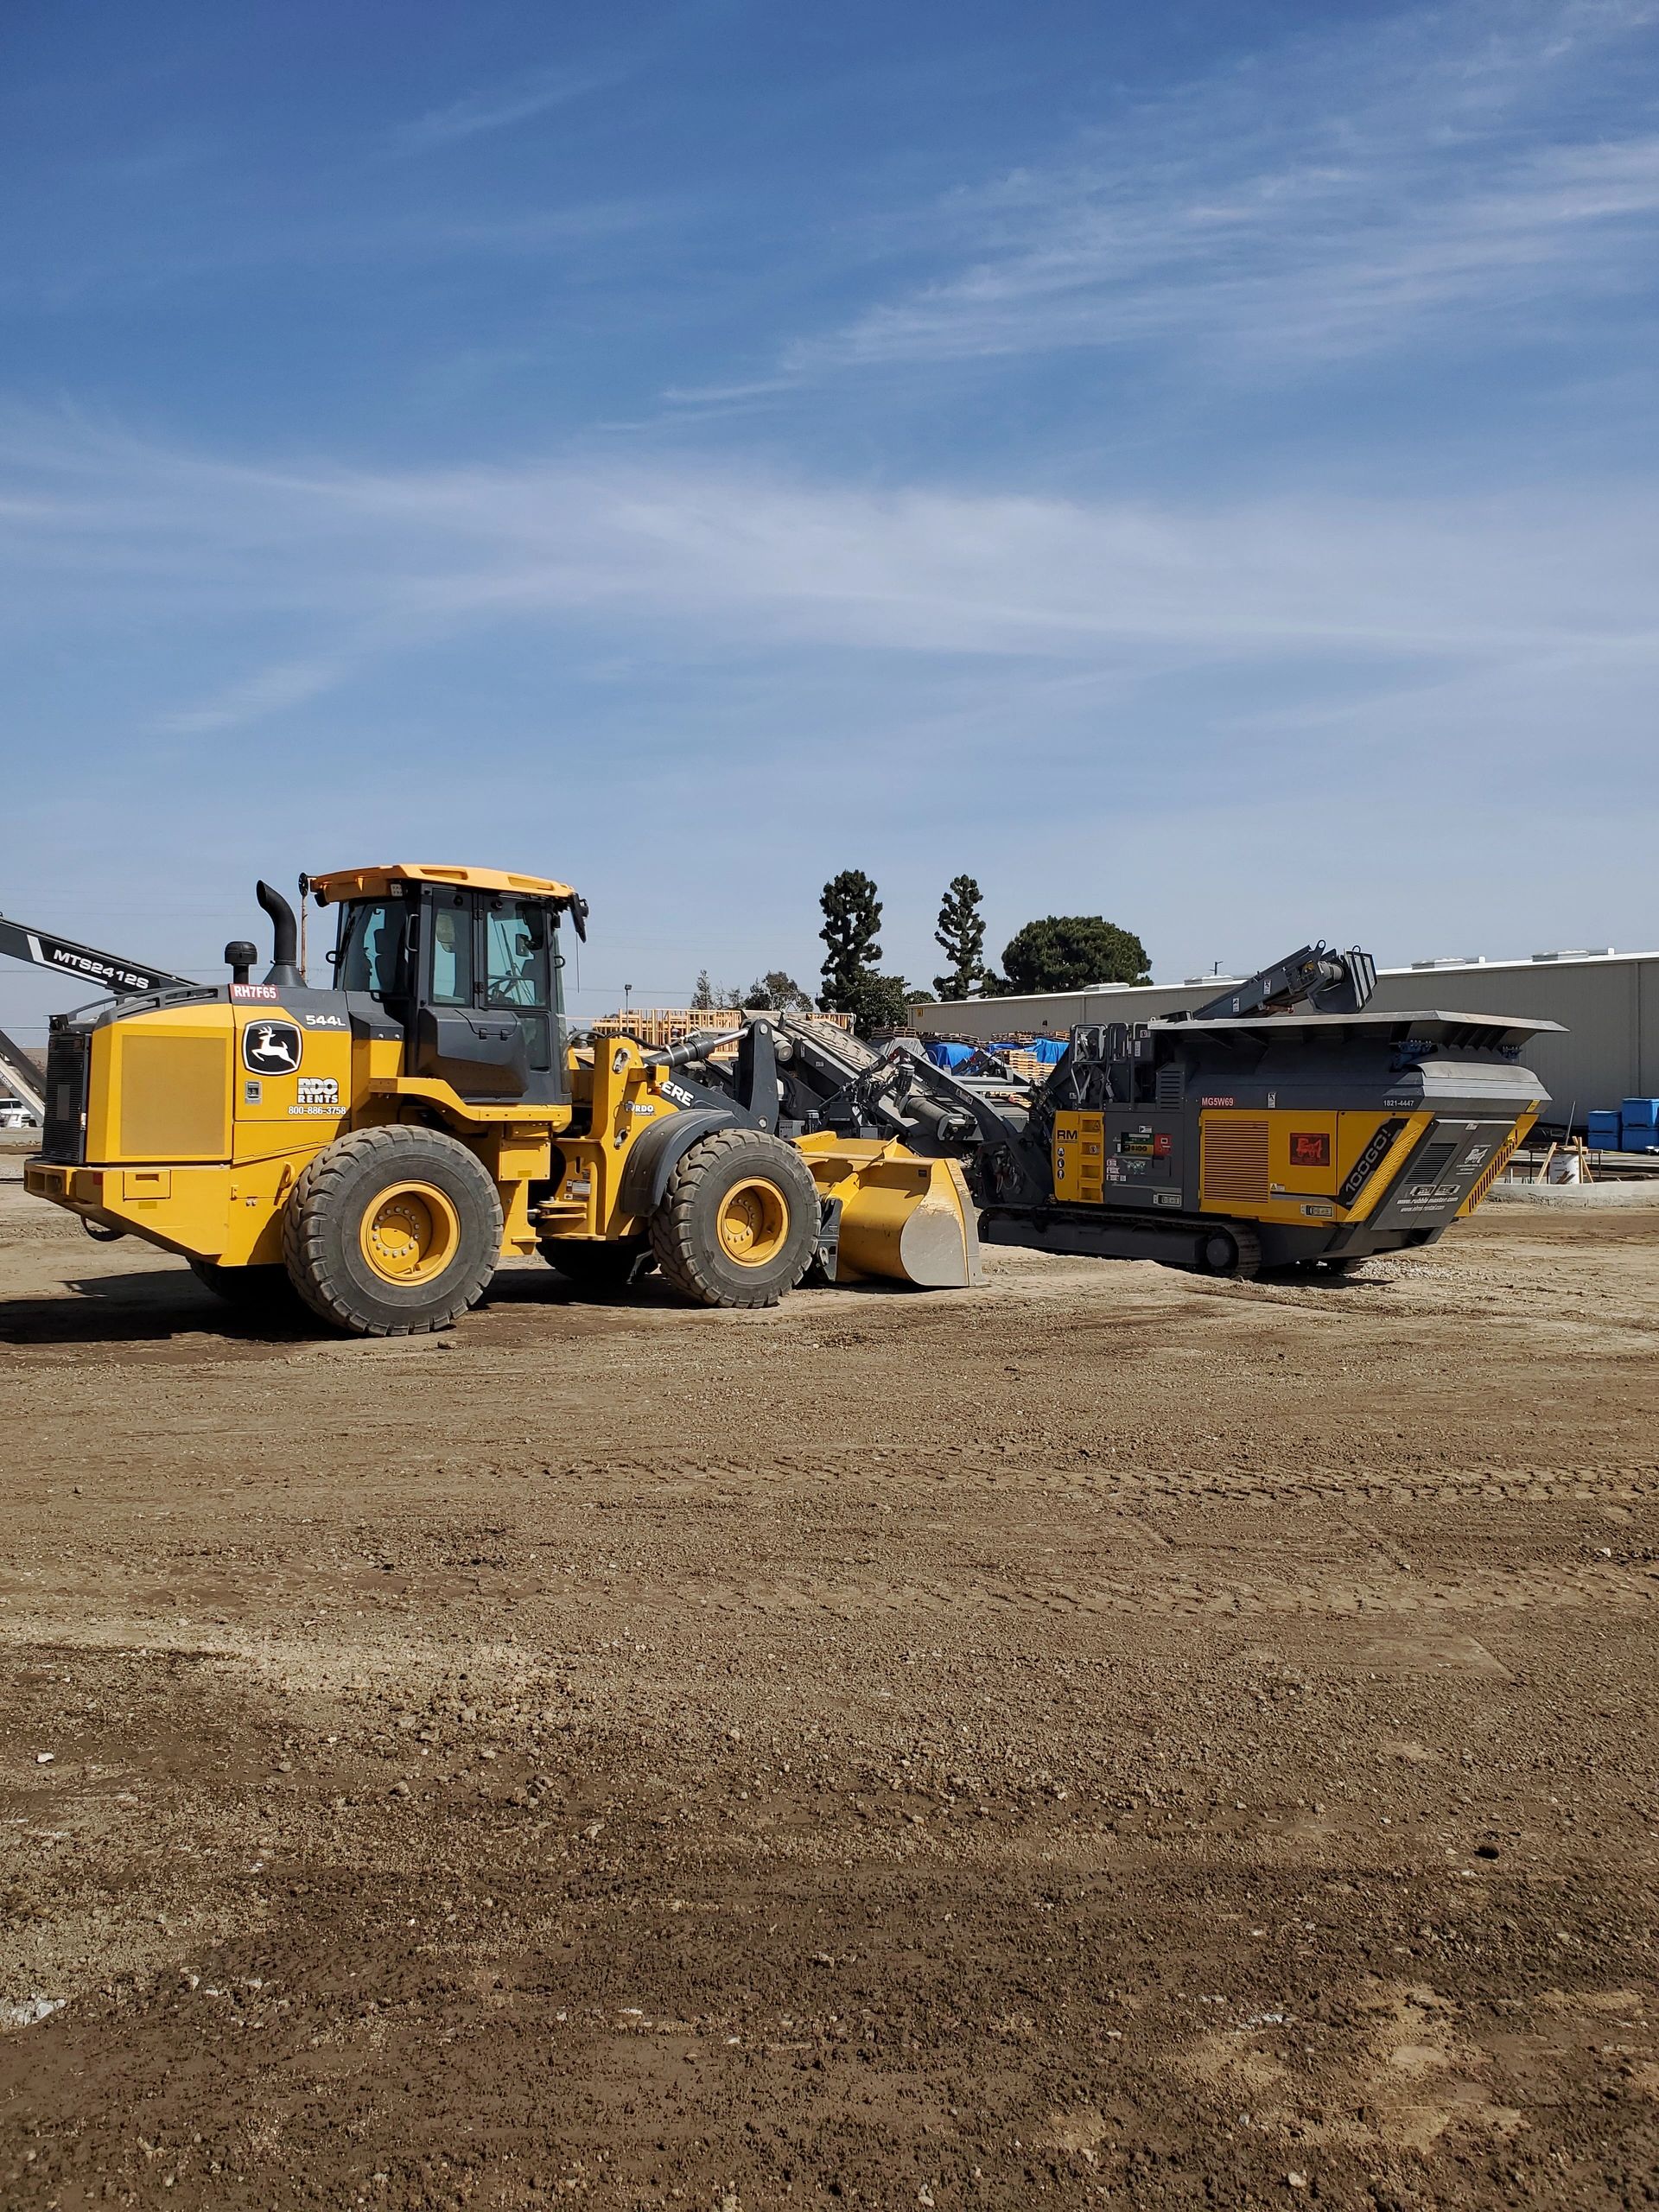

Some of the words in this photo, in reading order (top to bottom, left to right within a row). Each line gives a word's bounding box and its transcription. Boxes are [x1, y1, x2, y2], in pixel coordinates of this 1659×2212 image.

[53, 949, 149, 989] MTS2412S
[233, 985, 277, 999] RH7F65
[305, 1014, 346, 1027] 544L
[297, 1077, 339, 1095] RDO
[297, 1094, 339, 1103] RENTS
[660, 1080, 695, 1108] ERE
[1201, 1096, 1234, 1106] MG5W69
[288, 1106, 346, 1115] 800-886-3758
[635, 1104, 654, 1113] RDO
[1057, 1129, 1077, 1140] RM
[1345, 1128, 1391, 1193] 100GO!
